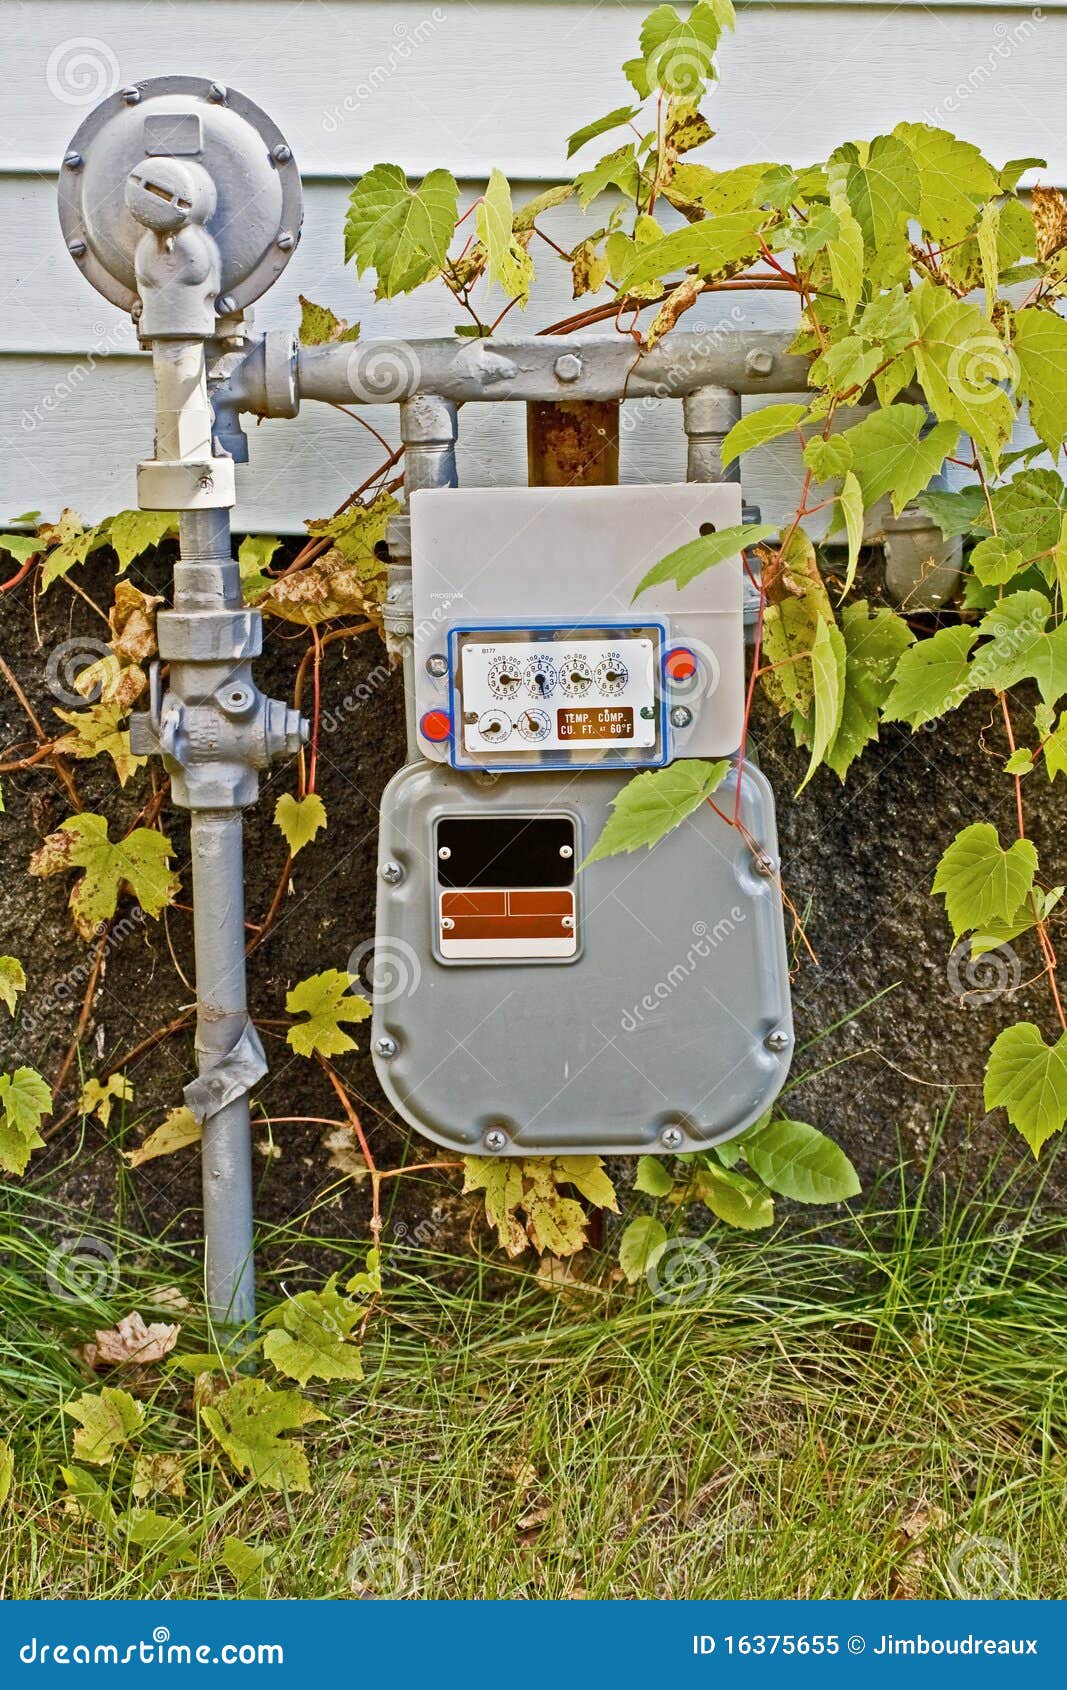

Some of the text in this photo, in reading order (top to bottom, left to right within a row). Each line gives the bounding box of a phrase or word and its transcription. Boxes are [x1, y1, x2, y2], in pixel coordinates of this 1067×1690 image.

[565, 712, 627, 723] TEMP. COMP.
[561, 725, 576, 734] CU.
[582, 725, 595, 734] FT.
